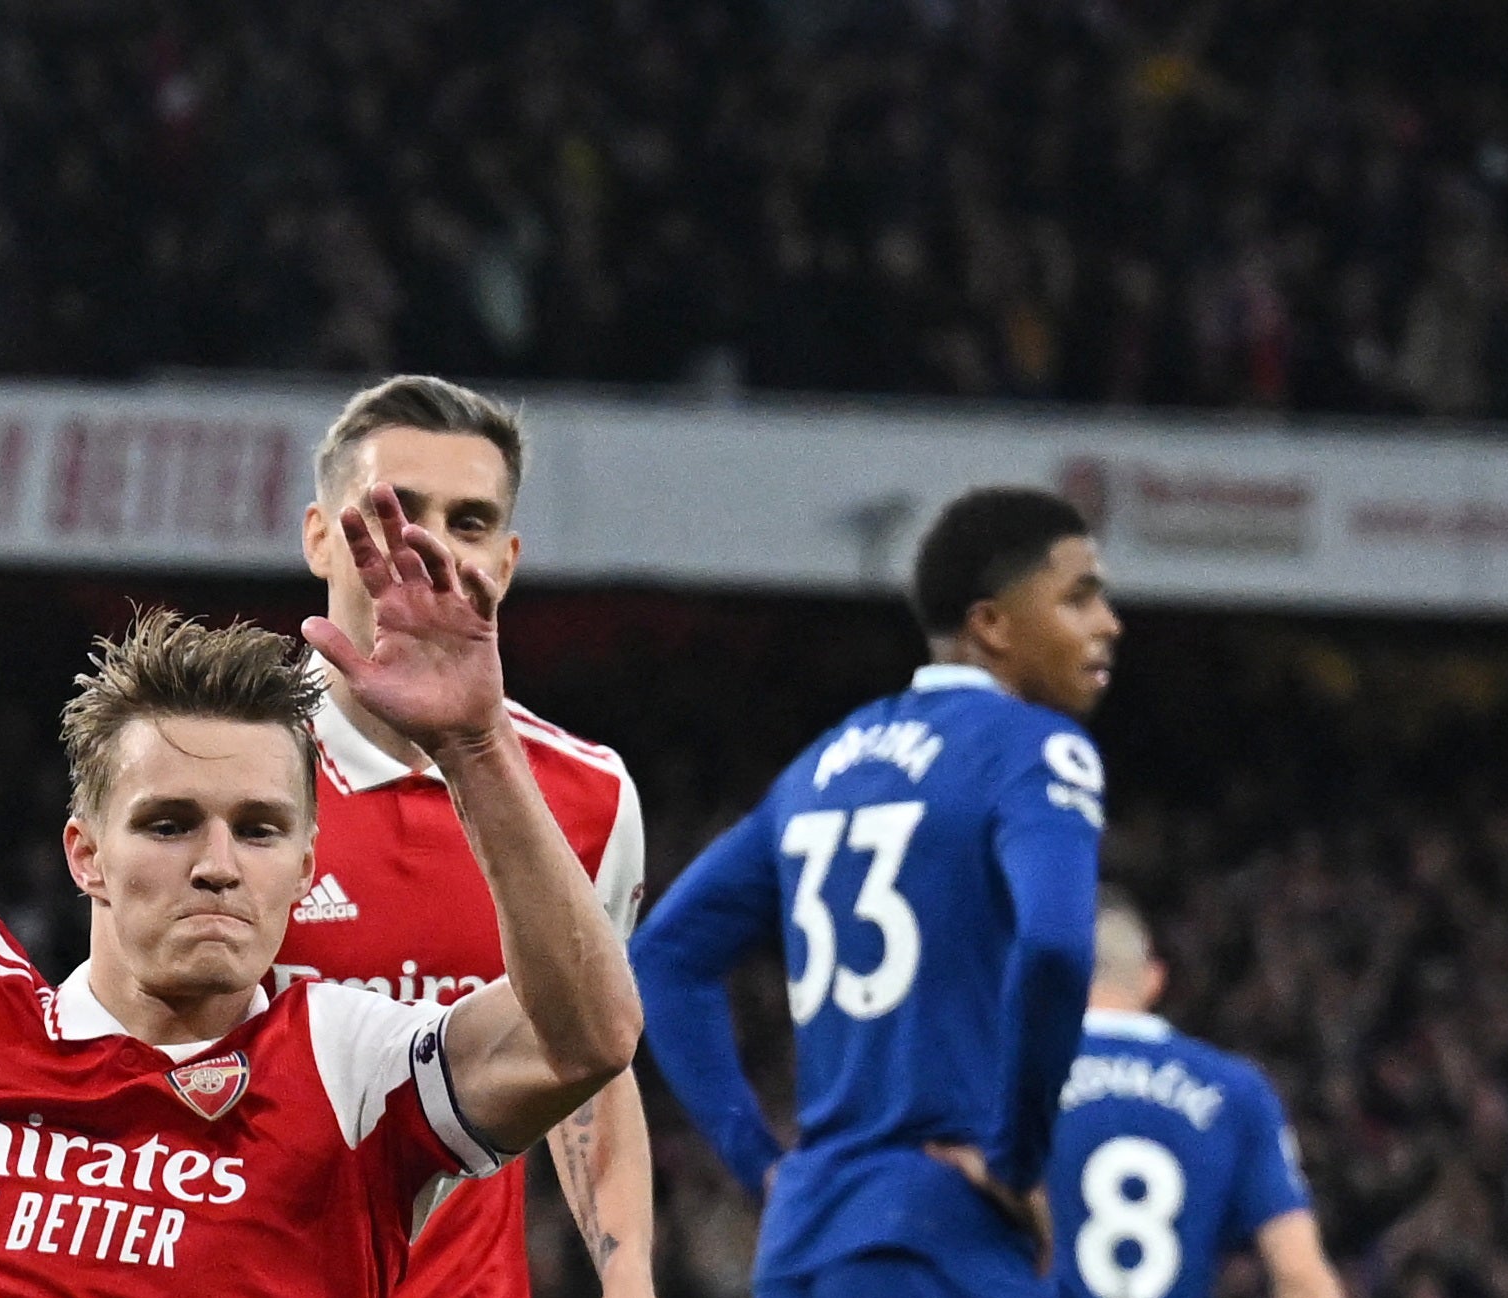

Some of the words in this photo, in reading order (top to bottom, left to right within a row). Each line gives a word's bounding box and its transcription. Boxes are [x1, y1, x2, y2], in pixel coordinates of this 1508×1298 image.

[293, 902, 358, 924] adidas
[780, 801, 926, 1026] 33
[5, 1191, 186, 1268] BETTER
